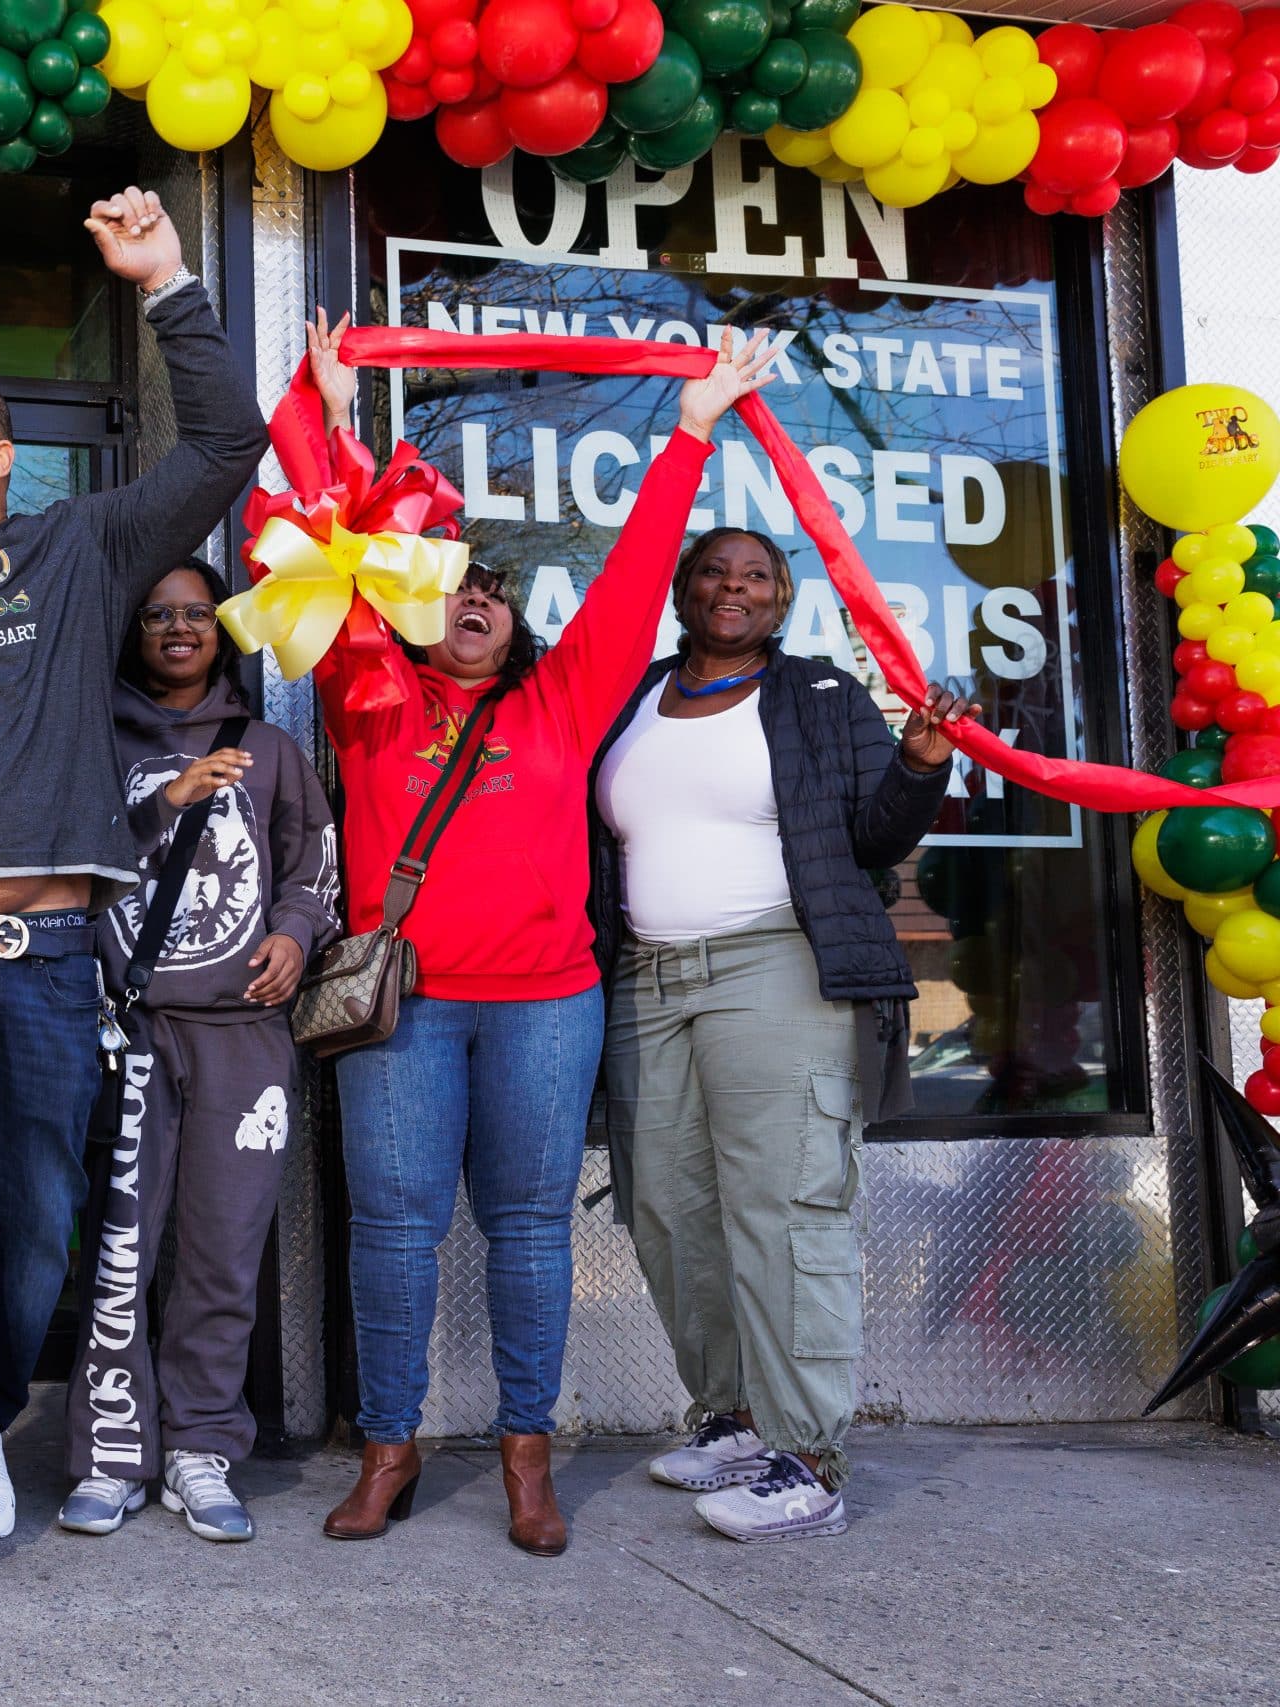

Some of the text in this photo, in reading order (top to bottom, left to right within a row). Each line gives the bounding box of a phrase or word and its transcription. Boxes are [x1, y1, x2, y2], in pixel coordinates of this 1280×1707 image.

[481, 134, 908, 281] OPEN
[822, 334, 1025, 401] STATE
[524, 565, 1048, 681] AABIS
[40, 915, 65, 928] Klein
[86, 1366, 142, 1479] SOUL
